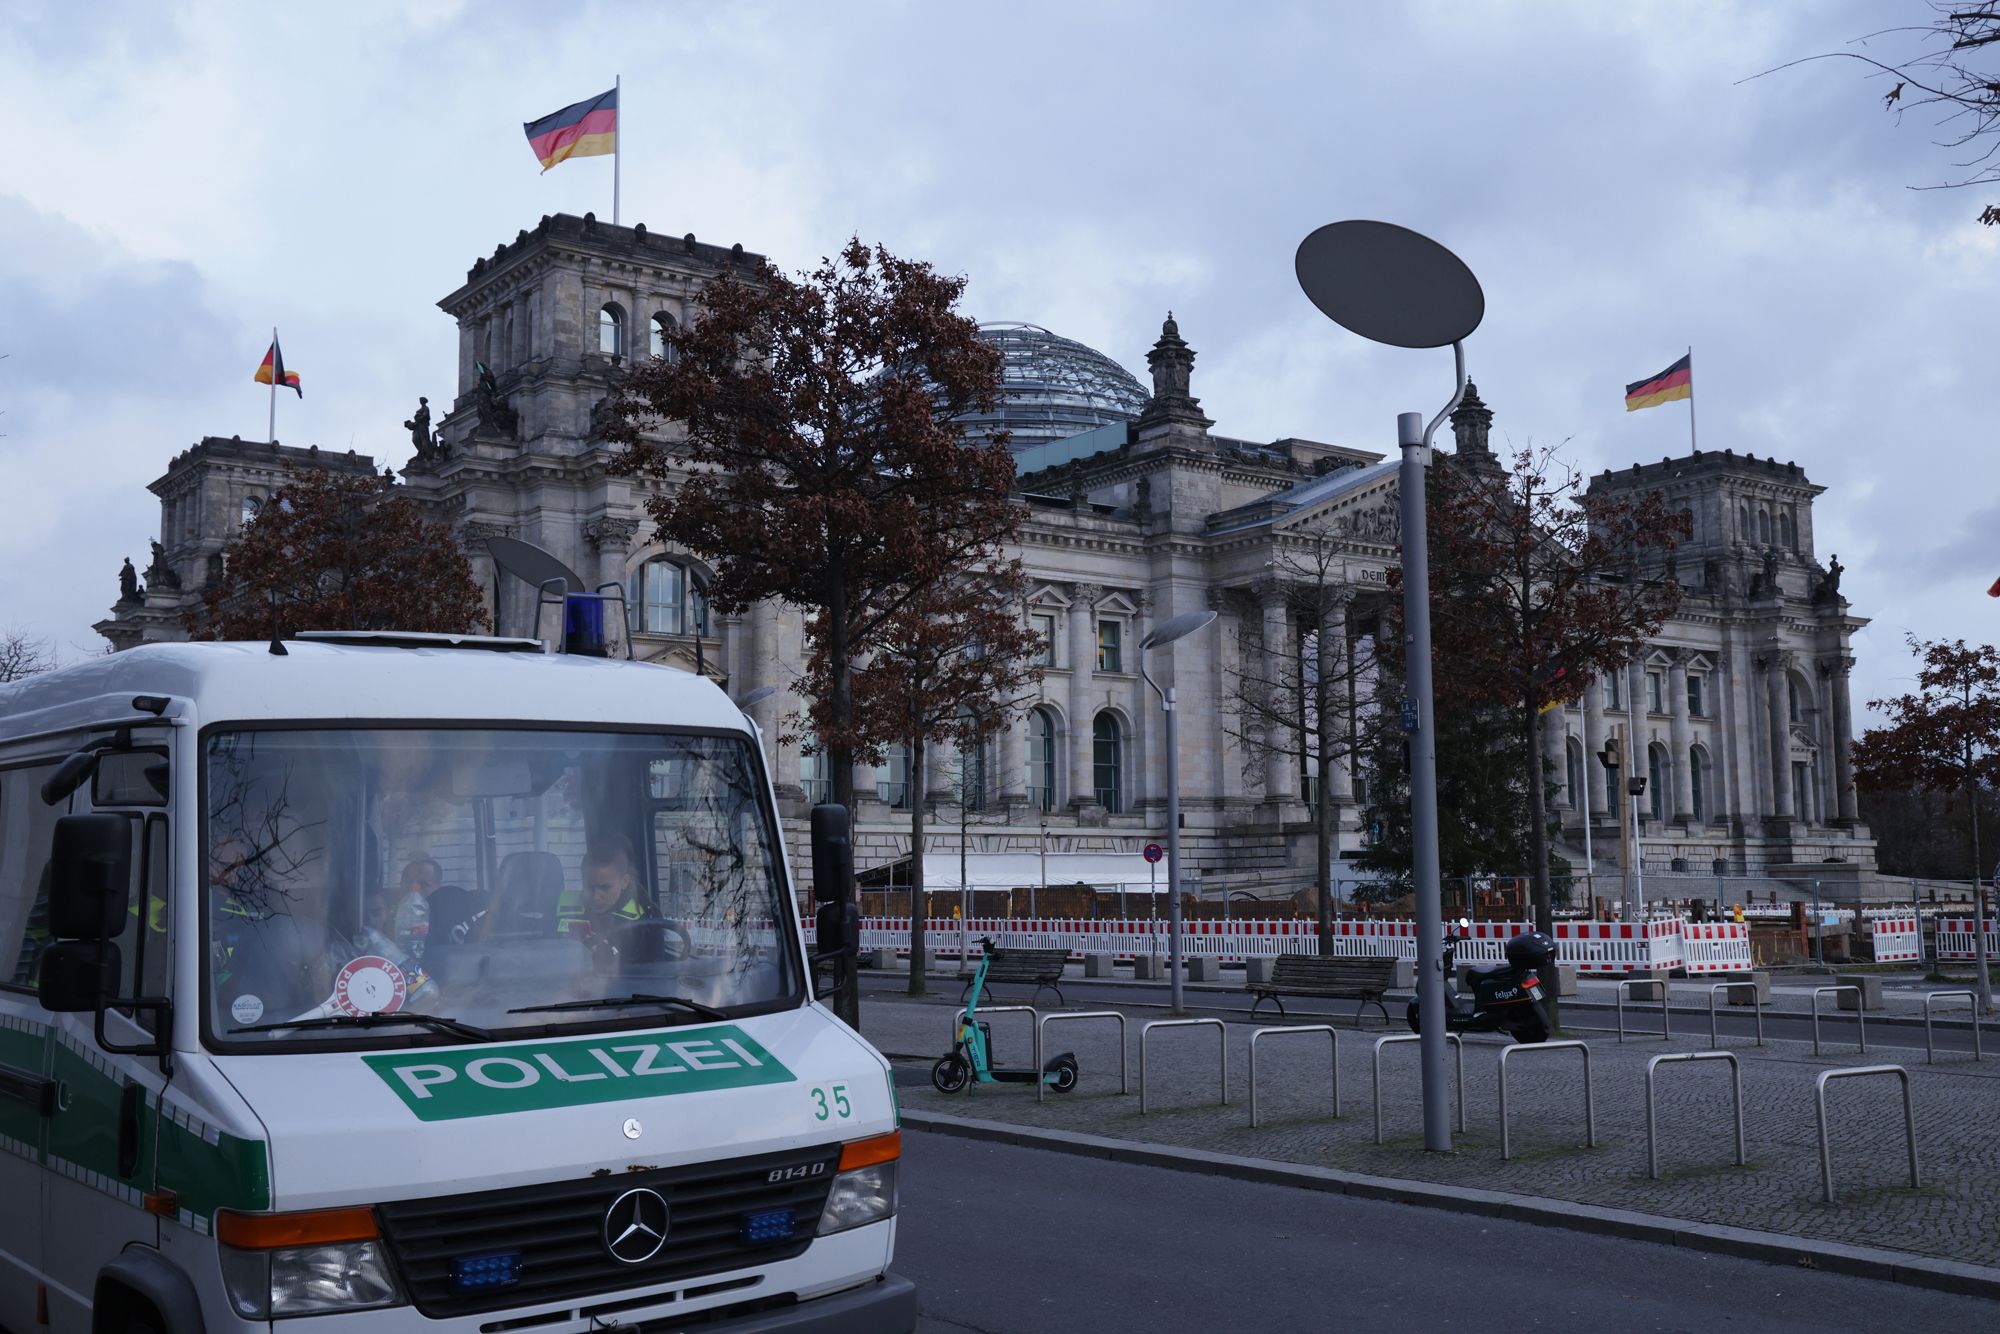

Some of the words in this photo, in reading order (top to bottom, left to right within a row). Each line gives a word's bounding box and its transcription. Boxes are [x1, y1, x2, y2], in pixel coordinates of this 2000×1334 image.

[382, 962, 404, 998] HALT
[392, 1038, 764, 1100] POLIZEI
[811, 1085, 851, 1121] 35
